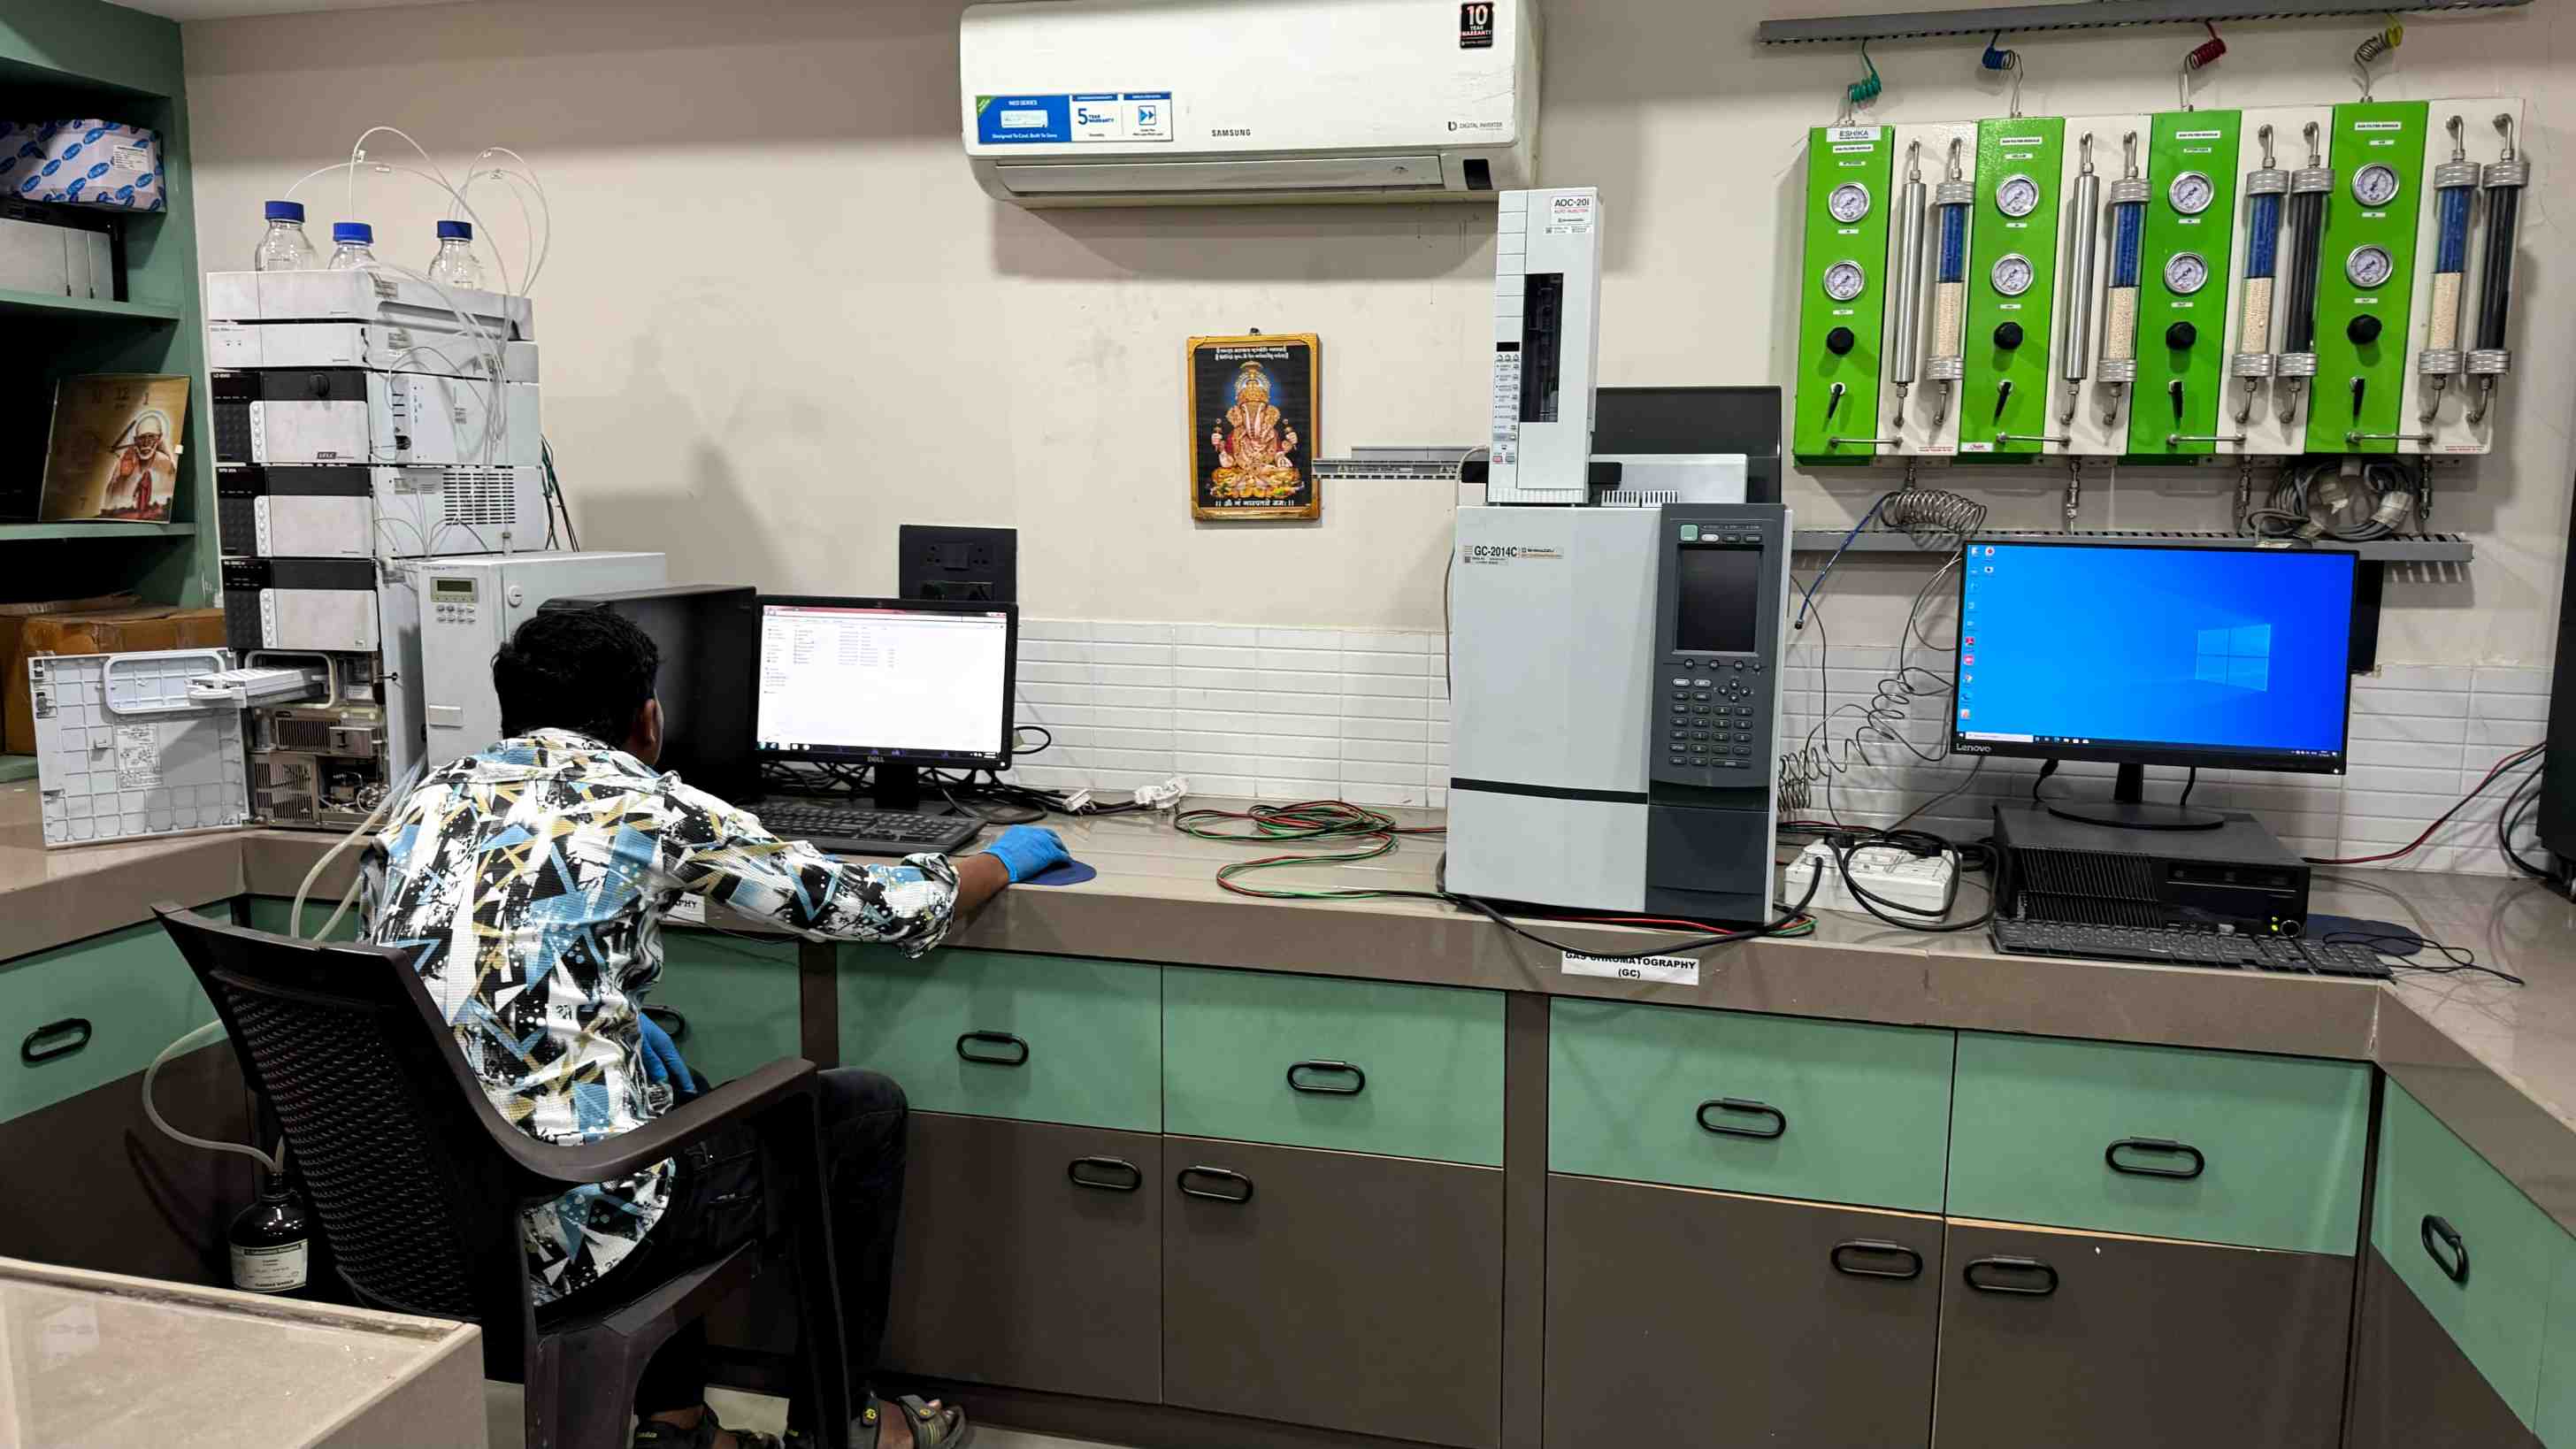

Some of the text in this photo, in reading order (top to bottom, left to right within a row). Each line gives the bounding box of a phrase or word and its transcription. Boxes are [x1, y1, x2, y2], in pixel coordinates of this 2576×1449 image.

[1467, 4, 1488, 26] 10
[1077, 107, 1088, 125] 5
[1211, 128, 1252, 137] SAMSUNG
[1474, 545, 1518, 557] GC-2014C
[1956, 743, 1991, 752] Lenovo
[1618, 968, 1641, 978] (GC)
